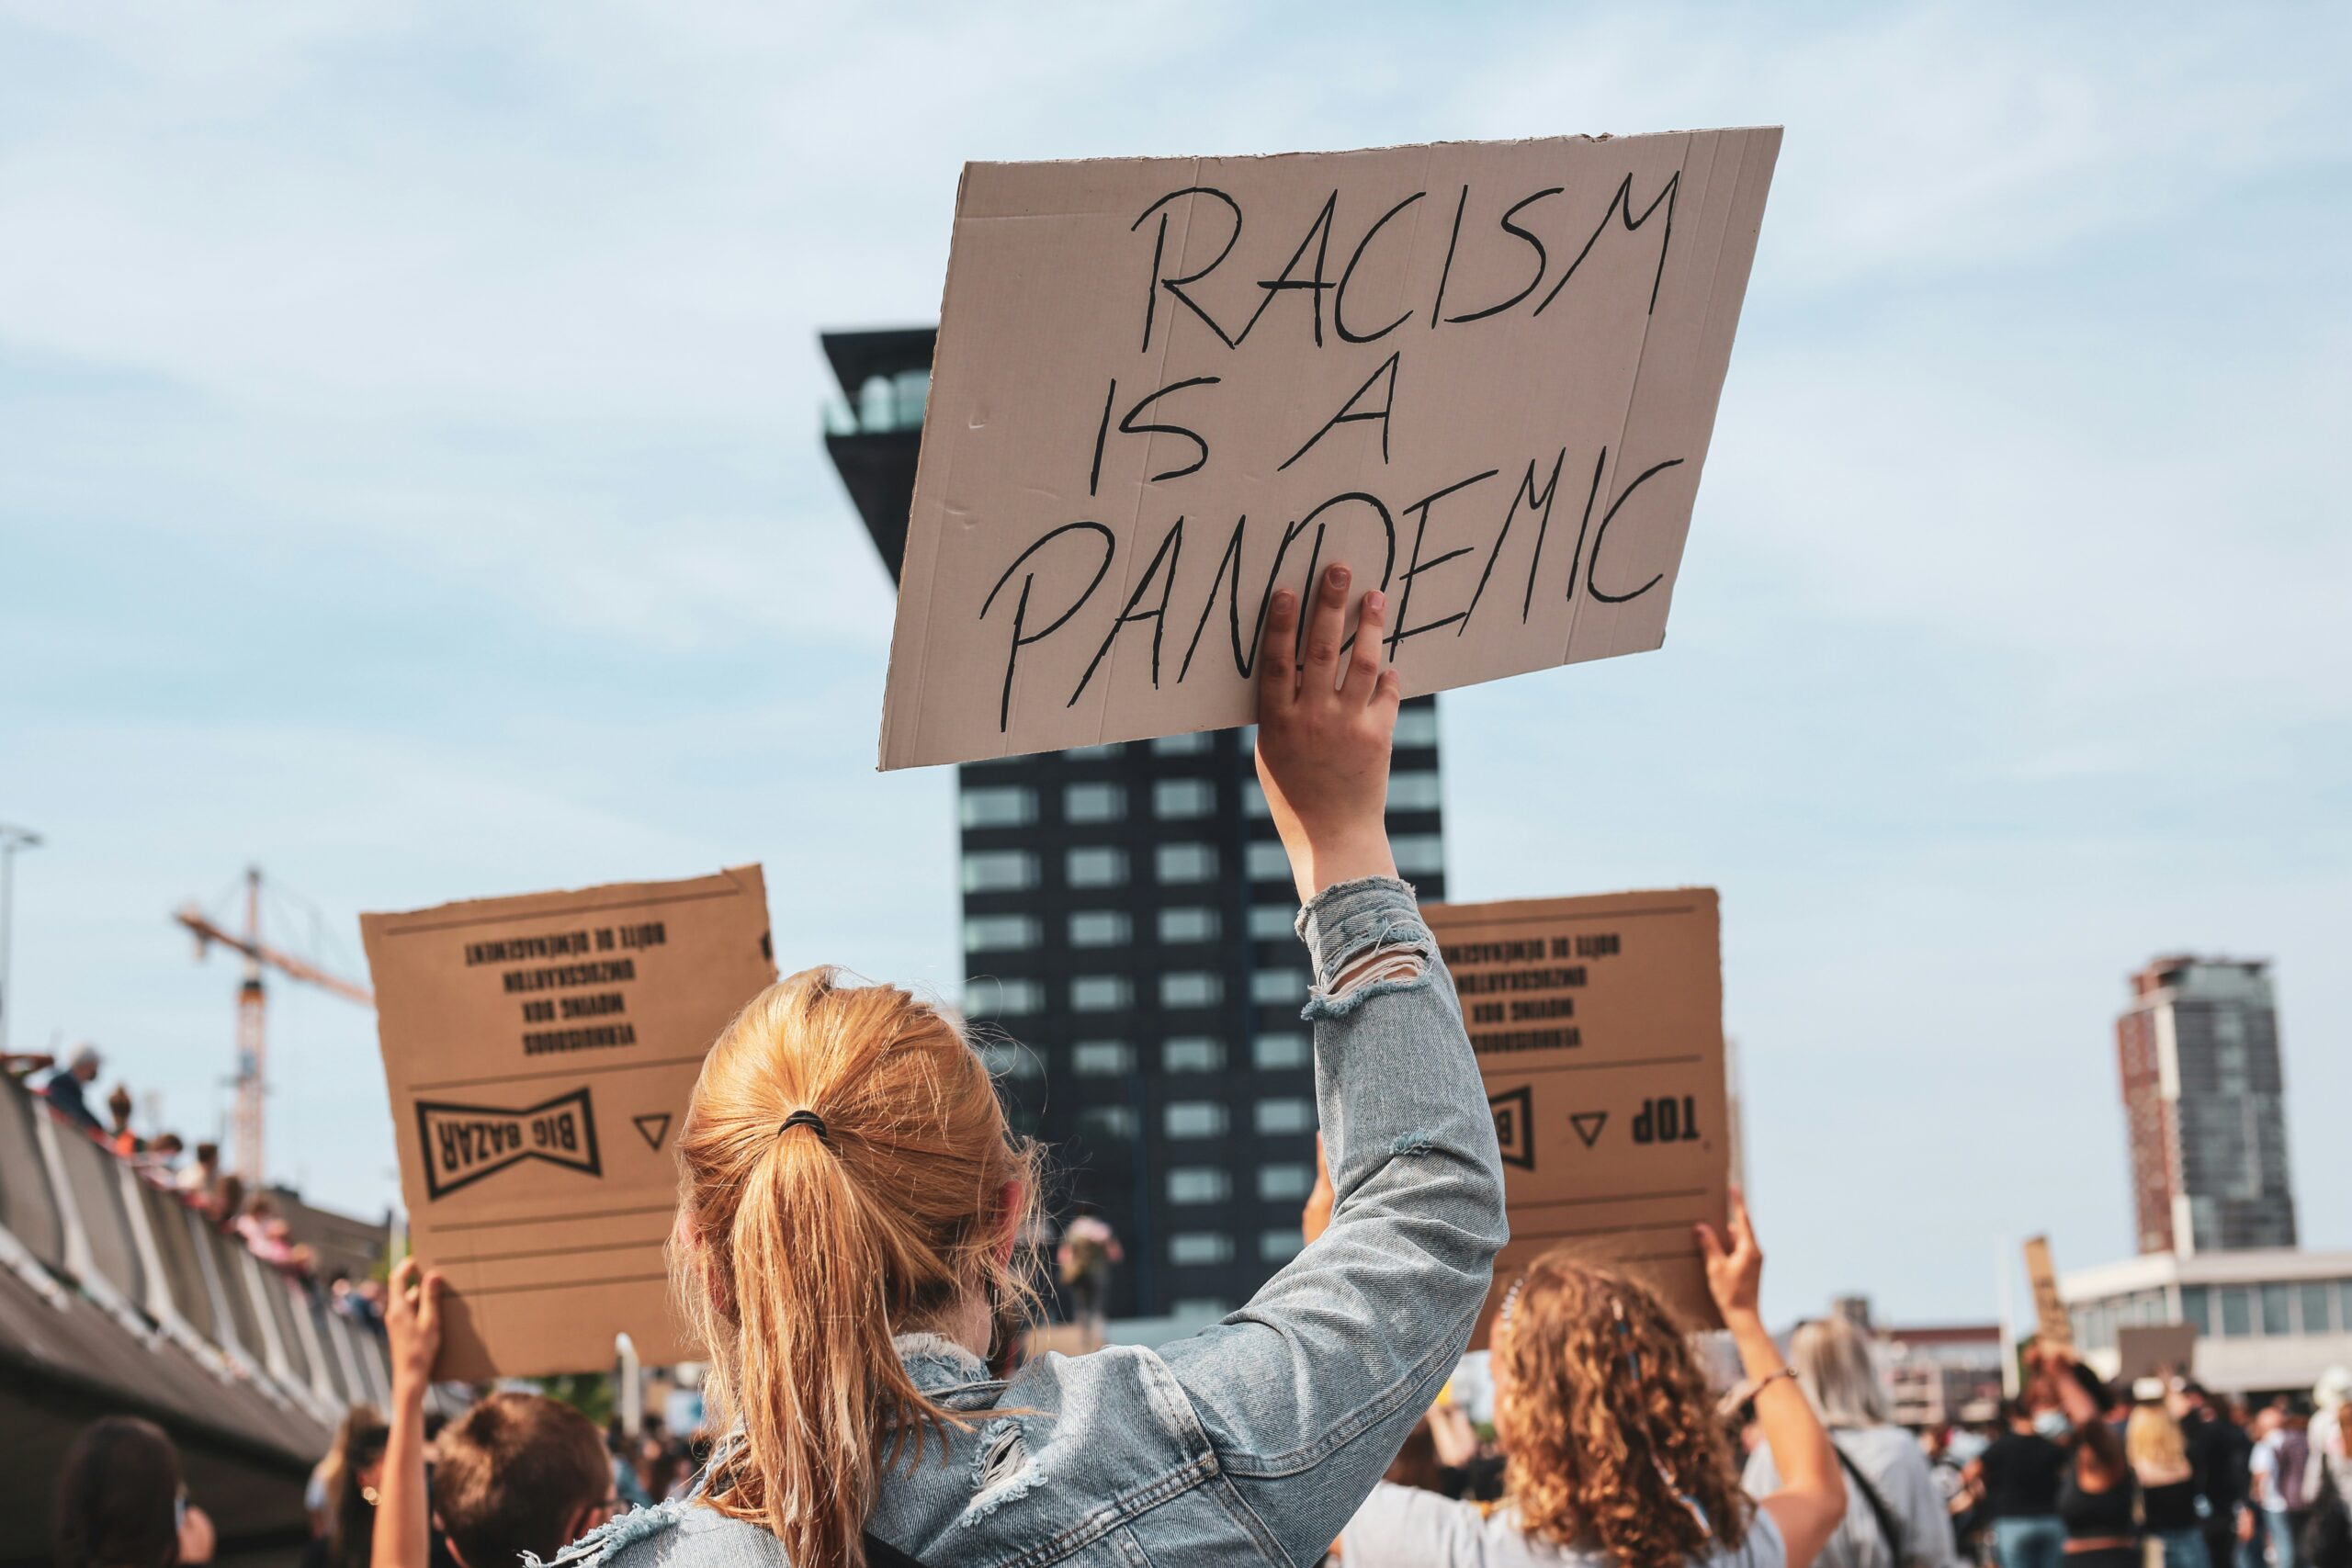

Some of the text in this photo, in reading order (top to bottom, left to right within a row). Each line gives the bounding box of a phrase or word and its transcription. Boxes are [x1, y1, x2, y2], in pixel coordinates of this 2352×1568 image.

[1131, 170, 1680, 353] RACISM
[1089, 350, 1399, 497] IS A
[979, 446, 1685, 733] PANDEMIC
[594, 927, 616, 953] DE
[521, 993, 626, 1024] MOVING BOX
[521, 1022, 637, 1056] VERHUISDOOS
[437, 1112, 578, 1172] BIG BAZAR
[1633, 1096, 1701, 1145] TOP
